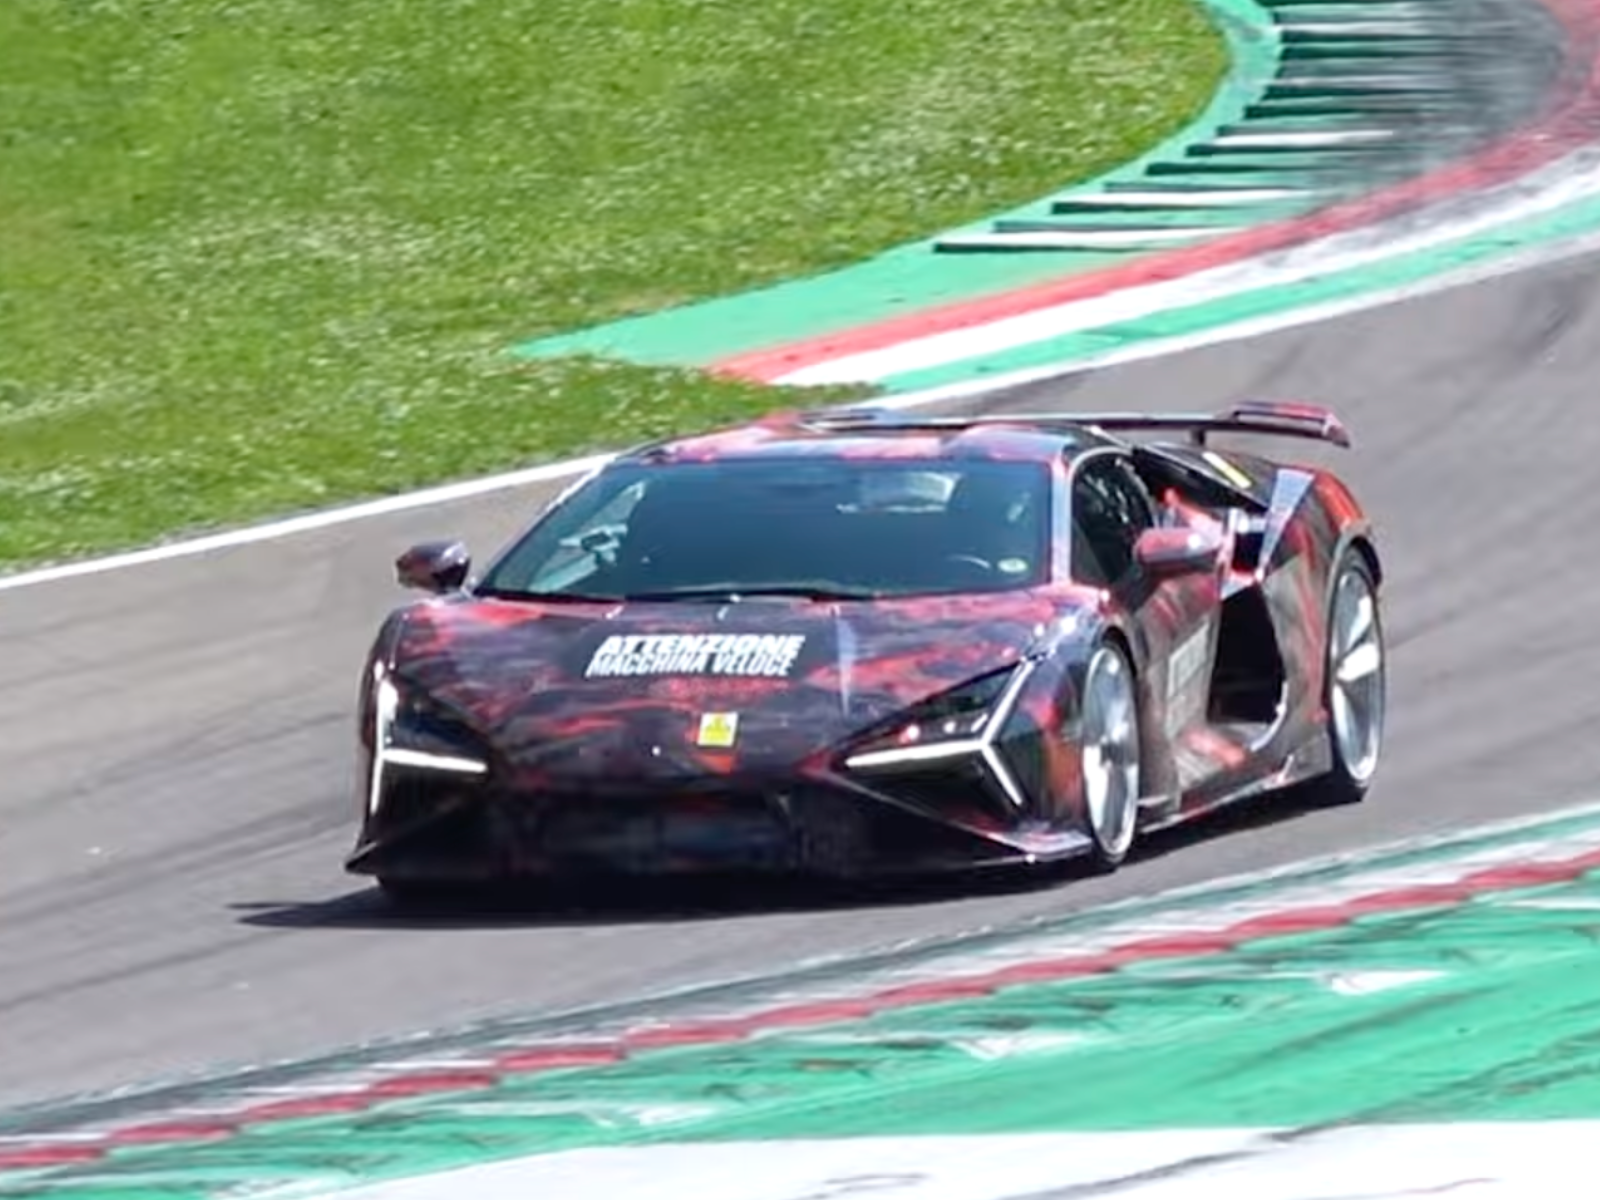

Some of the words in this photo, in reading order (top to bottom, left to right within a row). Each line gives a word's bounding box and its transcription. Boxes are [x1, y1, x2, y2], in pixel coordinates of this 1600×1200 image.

[593, 634, 806, 655] ATTENZIONE
[585, 651, 707, 676] MACCHINA
[713, 651, 791, 676] VELOCE
